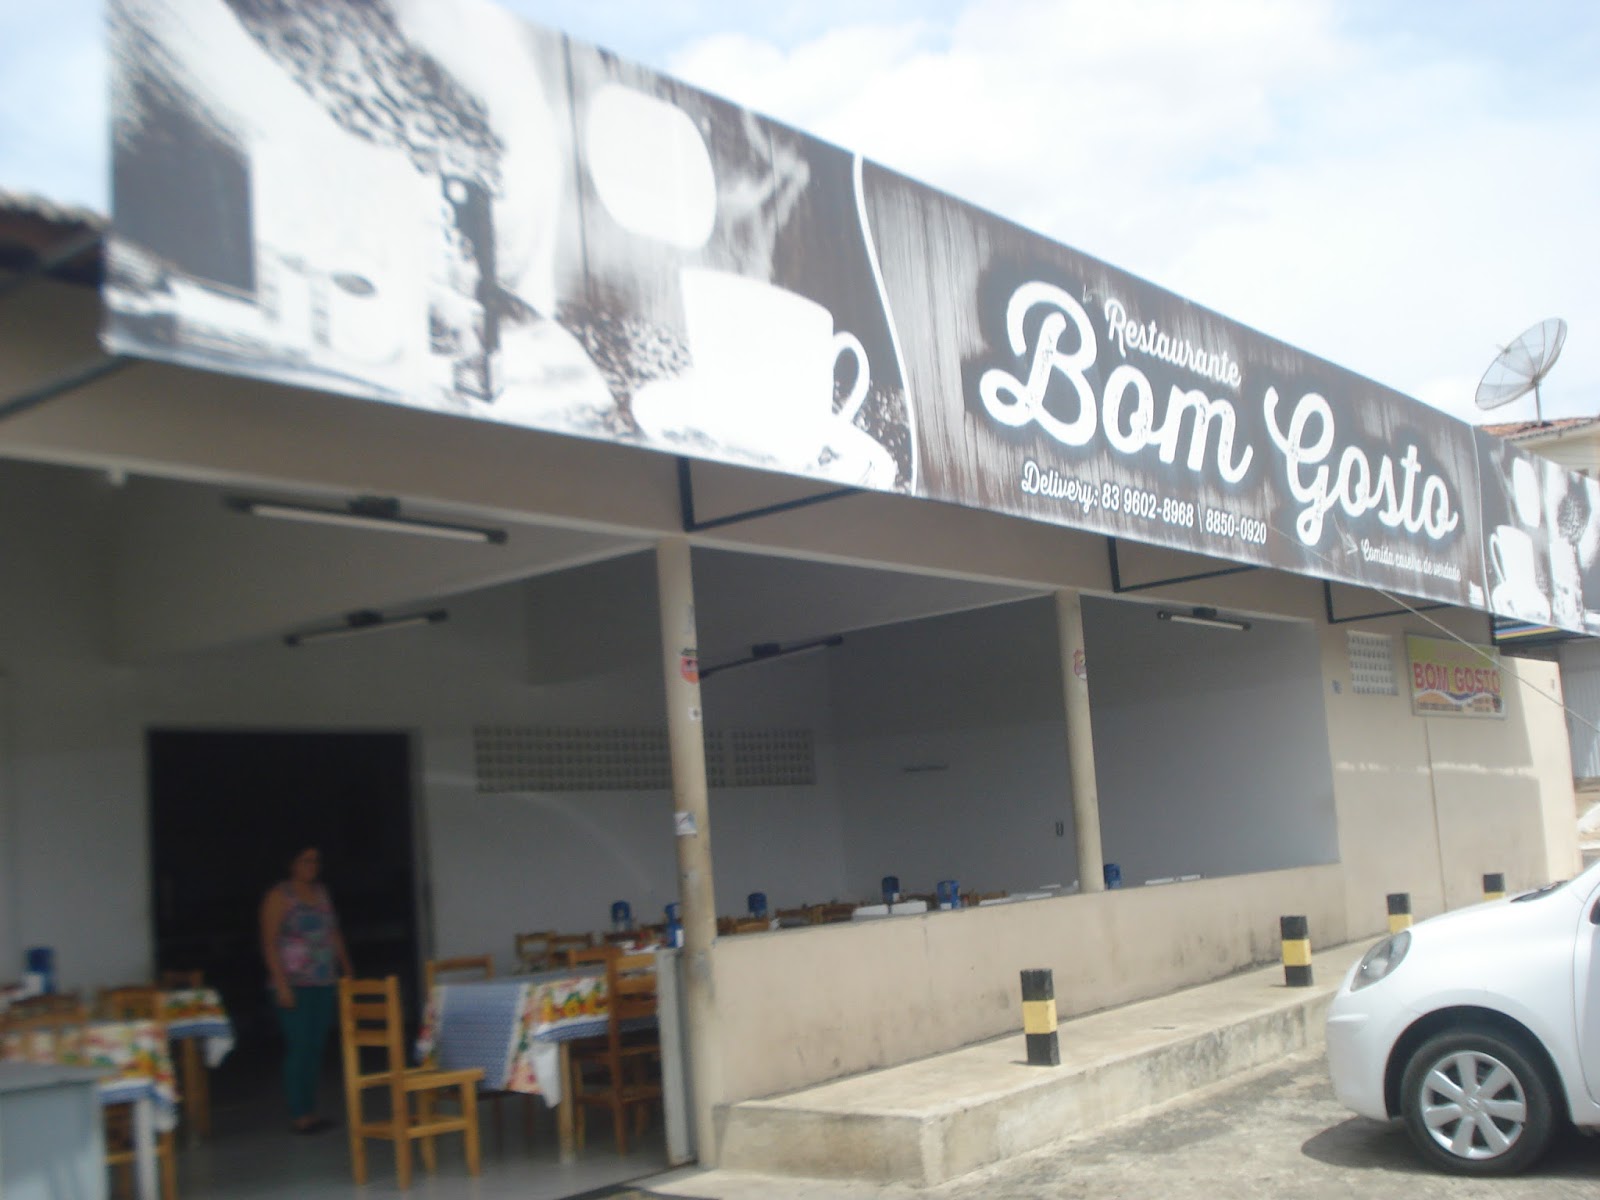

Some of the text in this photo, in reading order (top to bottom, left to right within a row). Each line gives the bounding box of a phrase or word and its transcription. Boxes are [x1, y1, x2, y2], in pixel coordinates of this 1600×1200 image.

[1104, 298, 1242, 389] Restaurante
[979, 280, 1459, 547] Bom Gosto
[1021, 460, 1099, 514] Delivery:
[1102, 482, 1121, 511] 83
[1123, 488, 1194, 528] 9602-8968
[1205, 508, 1267, 545] 8850-0920
[1360, 538, 1395, 567] Comida
[1413, 661, 1501, 694] BOM GOSTO
